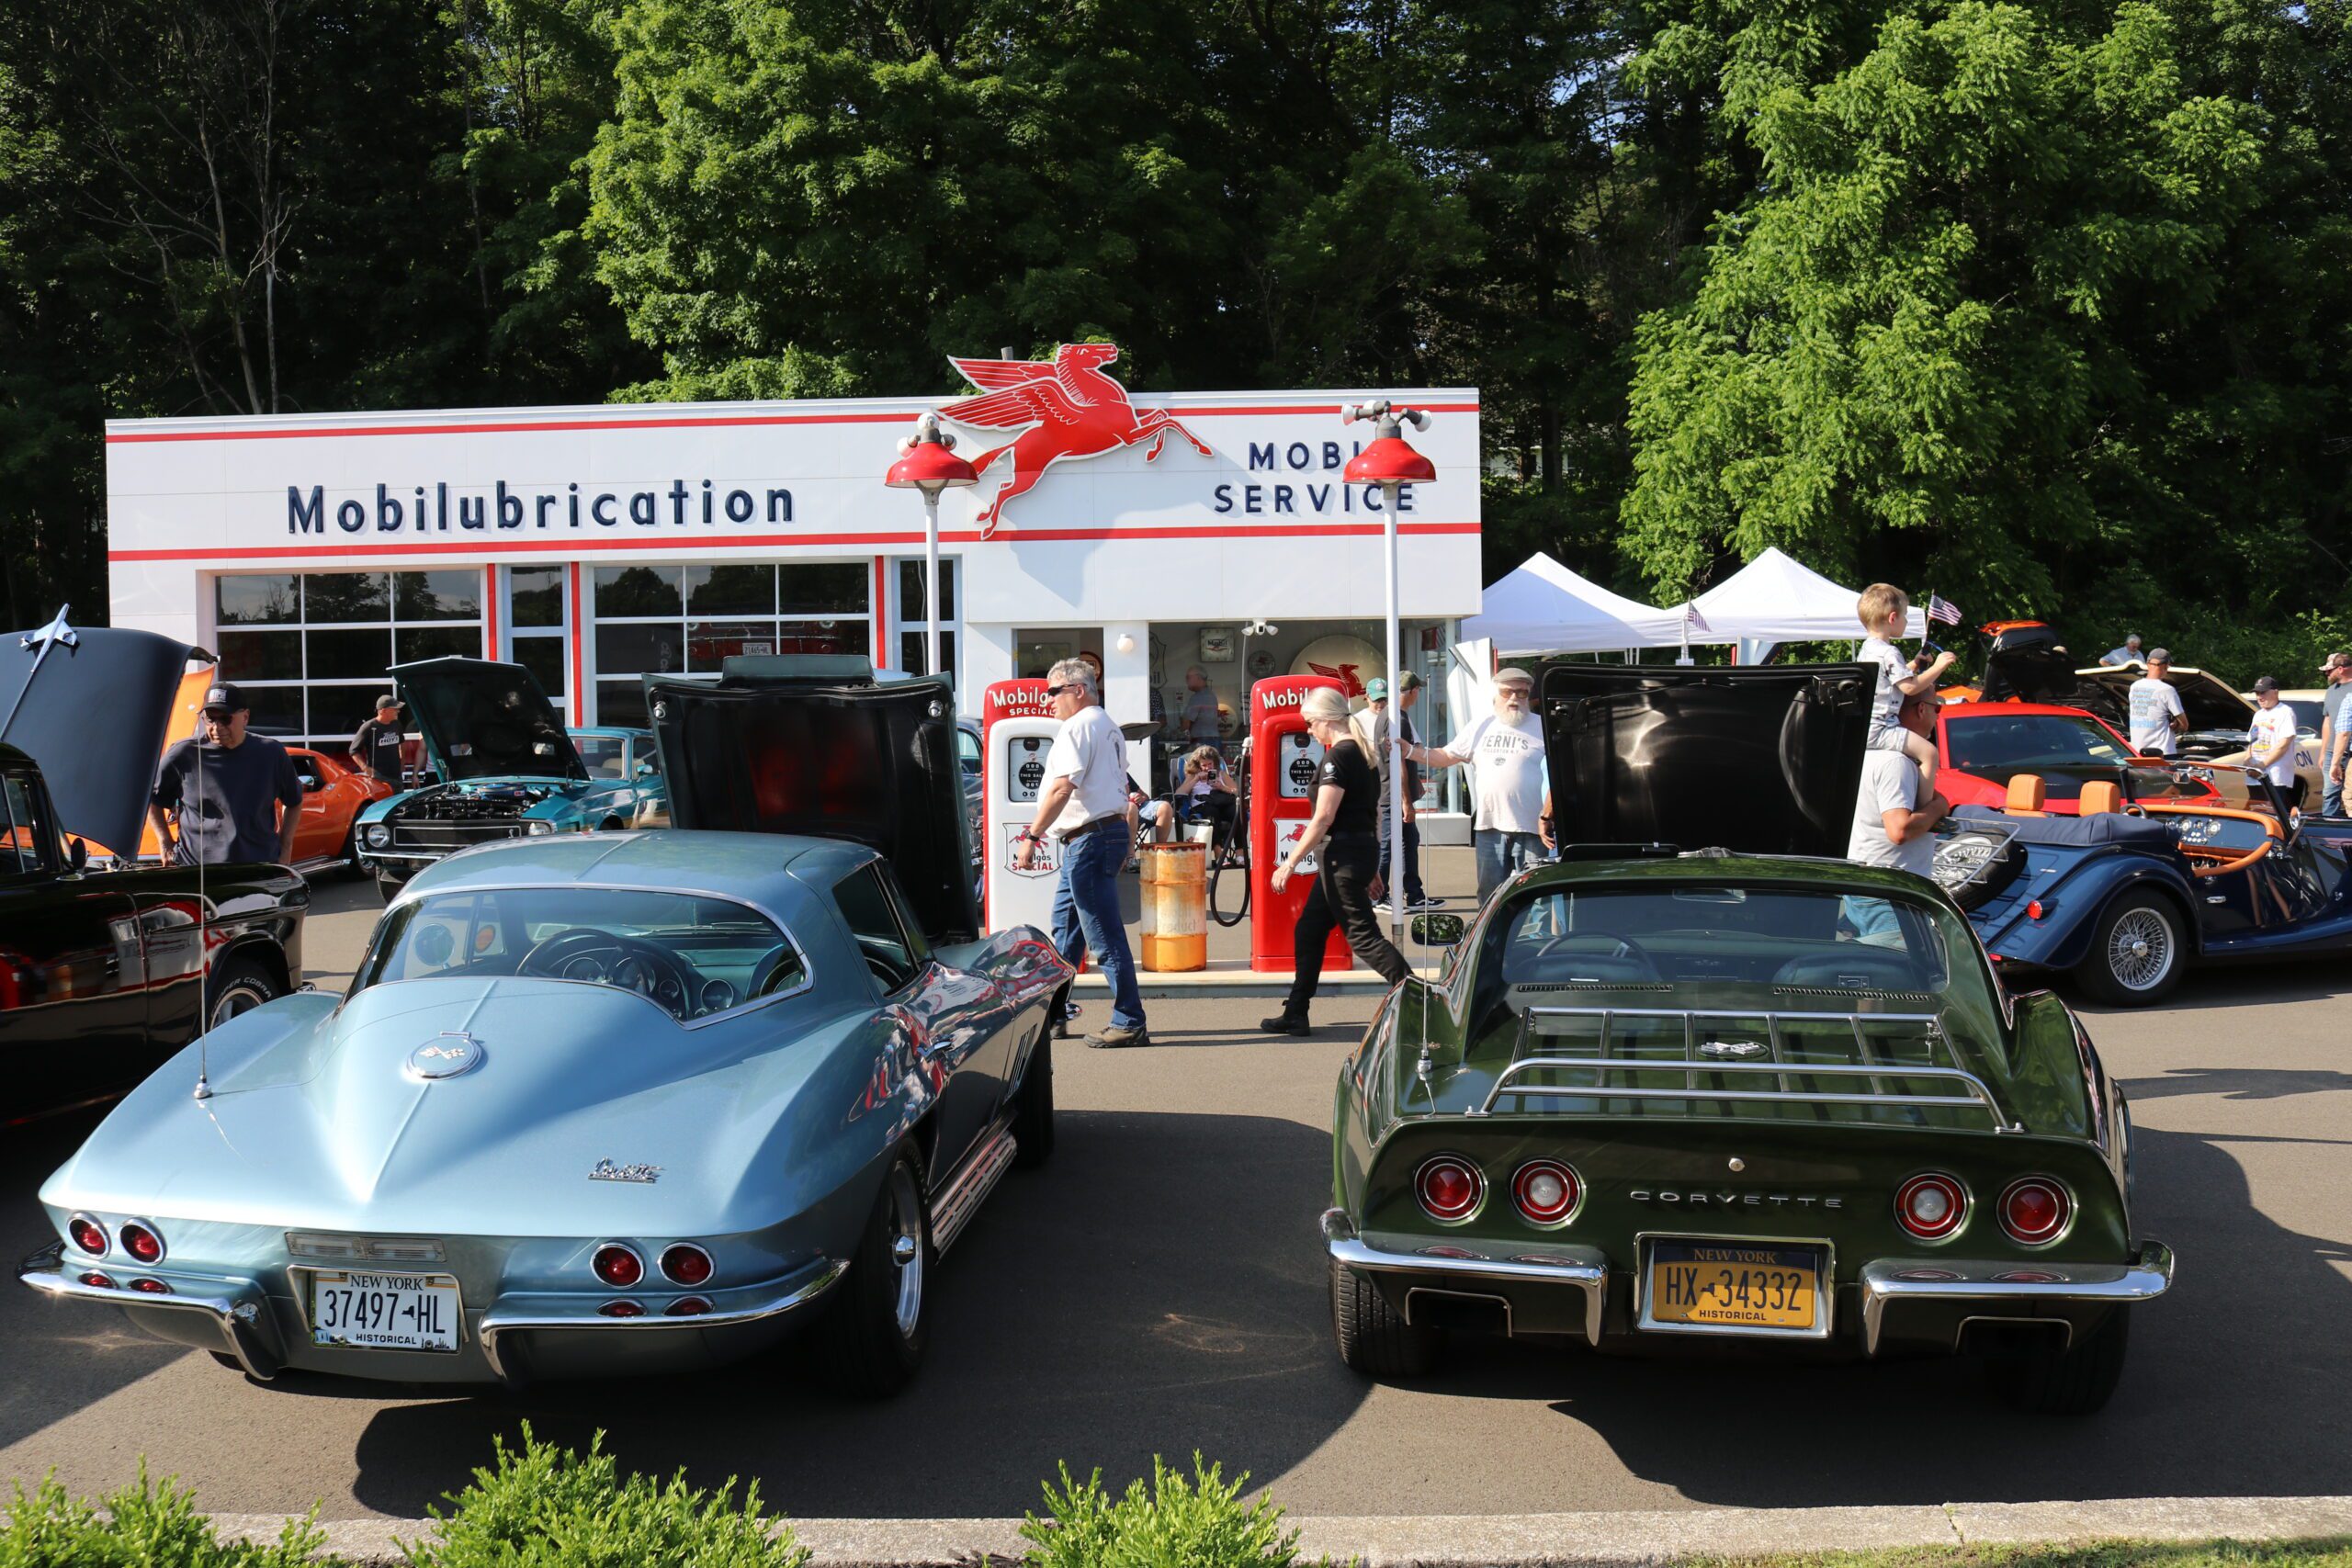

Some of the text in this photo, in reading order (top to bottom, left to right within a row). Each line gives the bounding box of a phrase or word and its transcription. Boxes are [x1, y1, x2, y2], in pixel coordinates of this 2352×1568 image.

[1249, 440, 1360, 470] MOBI
[288, 479, 792, 534] Mobilubrication
[1214, 483, 1413, 513] SERVICE
[992, 686, 1050, 708] Mobilg
[1261, 687, 1309, 709] Mobil
[1009, 706, 1056, 716] SPECIAL
[1013, 853, 1052, 863] Mlgas
[243, 976, 272, 998] COBRA
[1630, 1190, 1842, 1208] CORVETTE
[1693, 1248, 1777, 1265] NEW YORK
[350, 1274, 424, 1292] NEW YORK
[1666, 1266, 1802, 1312] HX 34332
[324, 1289, 446, 1334] 37497 HL
[1699, 1309, 1768, 1322] HISTORICAL
[356, 1332, 417, 1345] HISTORICAL
